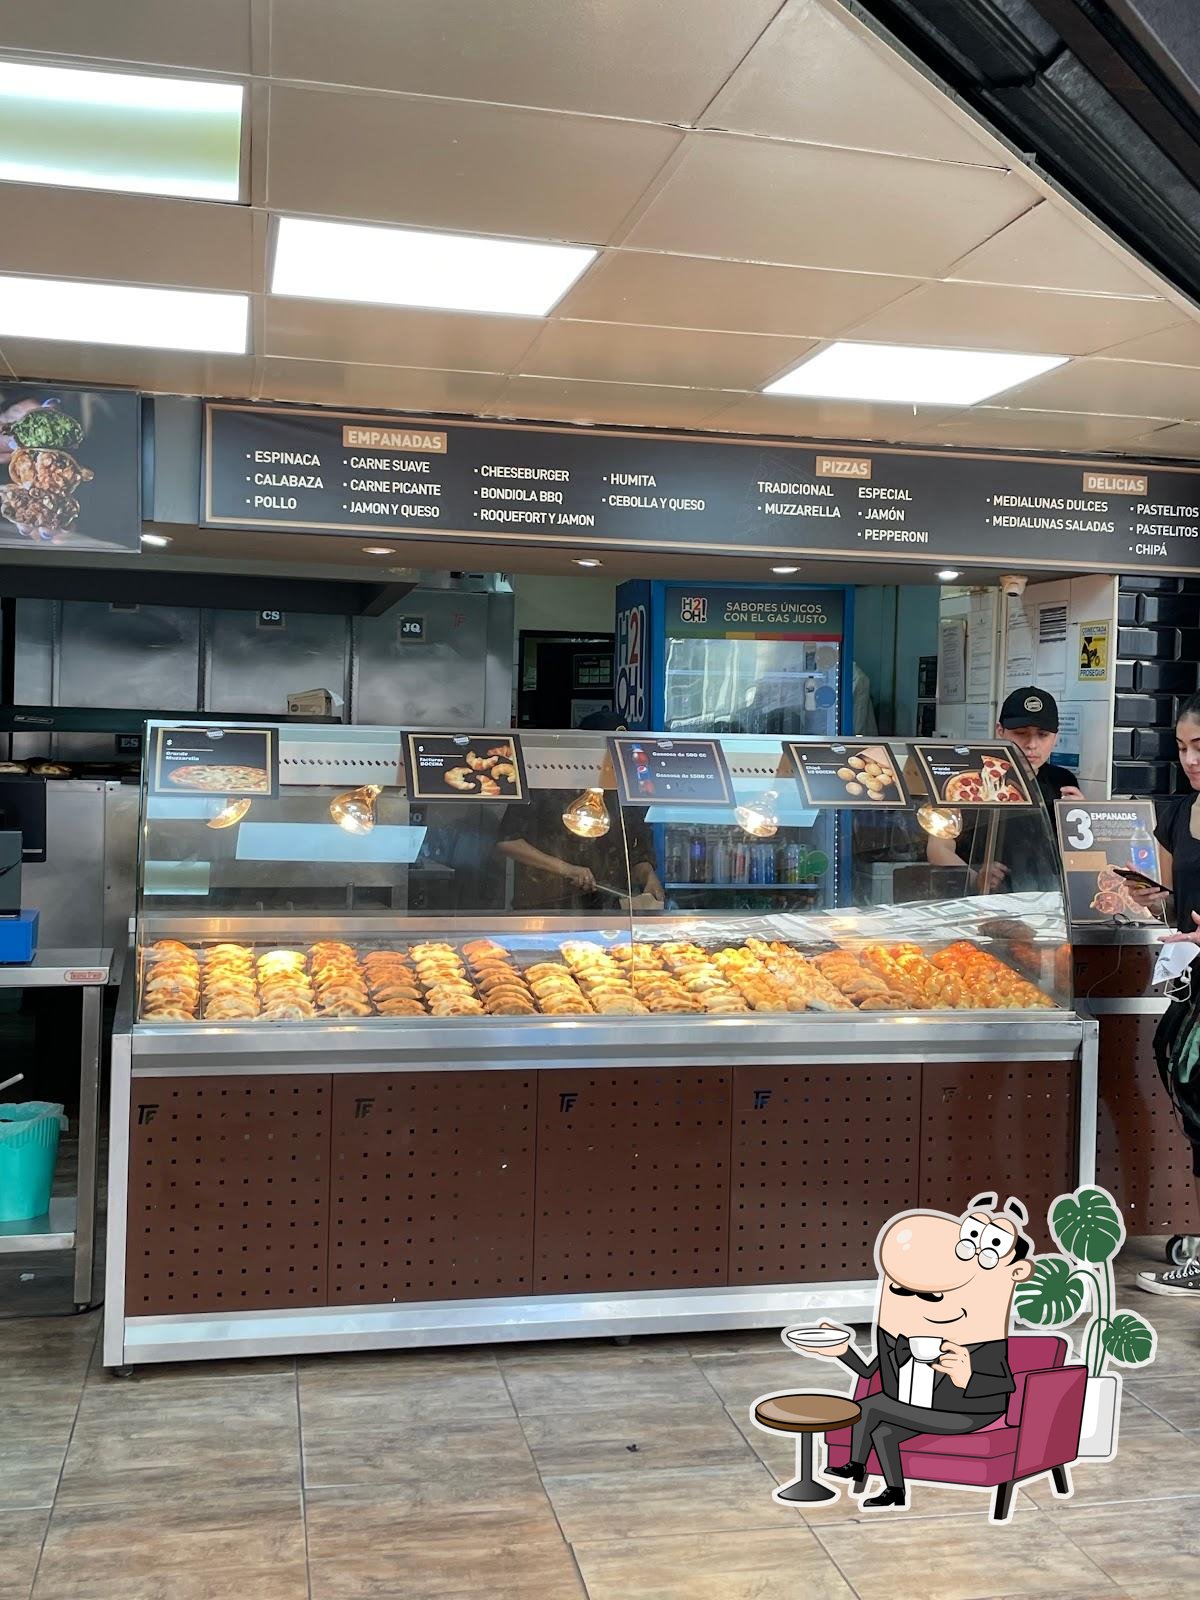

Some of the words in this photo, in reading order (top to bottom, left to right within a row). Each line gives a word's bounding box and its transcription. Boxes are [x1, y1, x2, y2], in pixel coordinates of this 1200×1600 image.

[347, 430, 442, 450] EMPANADAS
[255, 450, 321, 467] ESPINACA
[350, 457, 391, 472] CARNE
[392, 460, 430, 473] SUAVE
[481, 465, 570, 482] CHEESEBURGER
[822, 460, 868, 476] PIZZAS
[254, 473, 324, 489] CALABAZA
[350, 480, 391, 494] CARNE
[392, 482, 441, 496] PICANTE
[610, 473, 656, 487] HUMITA
[1088, 476, 1145, 492] DELICIAS
[481, 487, 537, 502] BONDIOLA
[540, 490, 563, 504] BBQ
[757, 481, 834, 497] TRADICIONAL
[858, 487, 912, 501] ESPECIAL
[254, 496, 297, 510] POLLO
[350, 502, 390, 515] JAMON
[390, 503, 399, 516] Y
[401, 504, 440, 518] QUESO
[608, 495, 658, 508] CEBOLLA
[659, 497, 668, 508] Y
[669, 497, 705, 511] QUESO
[765, 503, 841, 518] MUZZARELLA
[993, 495, 1065, 510] MEDIALUNAS
[1066, 499, 1108, 513] DULCES
[1136, 503, 1199, 518] PASTELITOS
[481, 509, 547, 524] ROQUEFORT
[548, 512, 557, 524] Y
[557, 513, 595, 527] JAMON
[865, 506, 905, 521] JAMÓN
[993, 515, 1064, 530] MEDIALUNAS
[1065, 519, 1115, 533] SALADAS
[1136, 524, 1199, 538] PASTELITOS
[864, 529, 928, 543] PEPPERONI
[1135, 542, 1167, 556] CHIPÁ
[262, 610, 280, 621] CS
[726, 602, 778, 613] SABORES
[780, 601, 822, 614] ÚNICOS
[723, 612, 749, 622] CON
[751, 612, 764, 622] EL
[768, 613, 790, 623] GAS
[792, 613, 827, 624] JUSTO
[402, 621, 421, 634] JQ
[1090, 812, 1137, 821] EMPANADAS
[1065, 808, 1094, 850] 3
